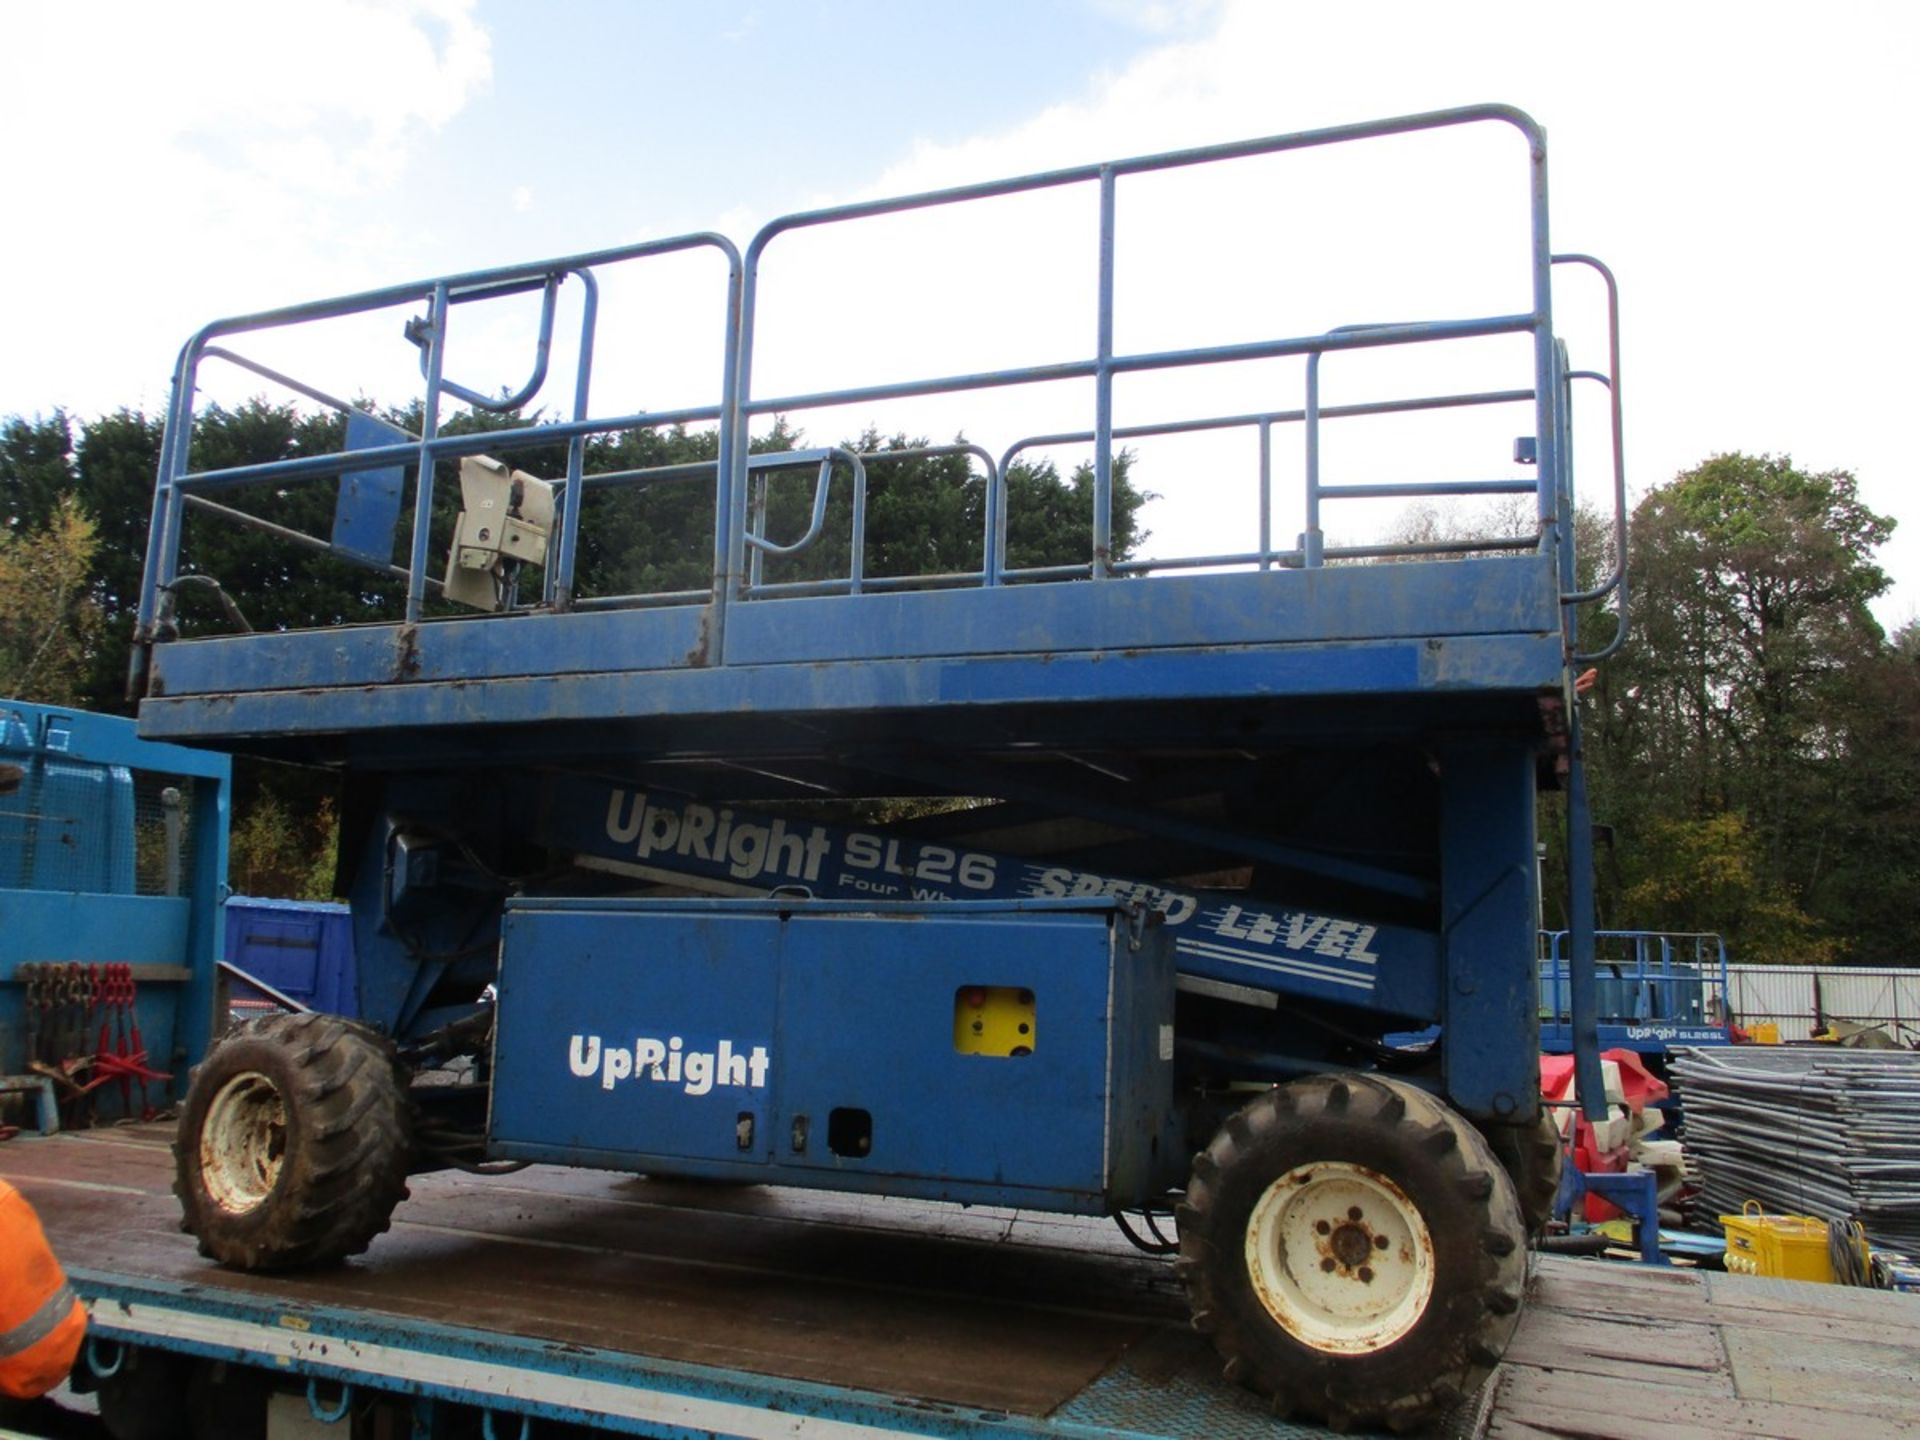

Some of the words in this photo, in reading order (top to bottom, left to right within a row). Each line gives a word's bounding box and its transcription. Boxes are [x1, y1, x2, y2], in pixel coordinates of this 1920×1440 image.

[606, 789, 830, 881] UpRight
[844, 832, 997, 890] SL26
[838, 873, 898, 895] Four
[569, 1035, 769, 1095] UpRight
